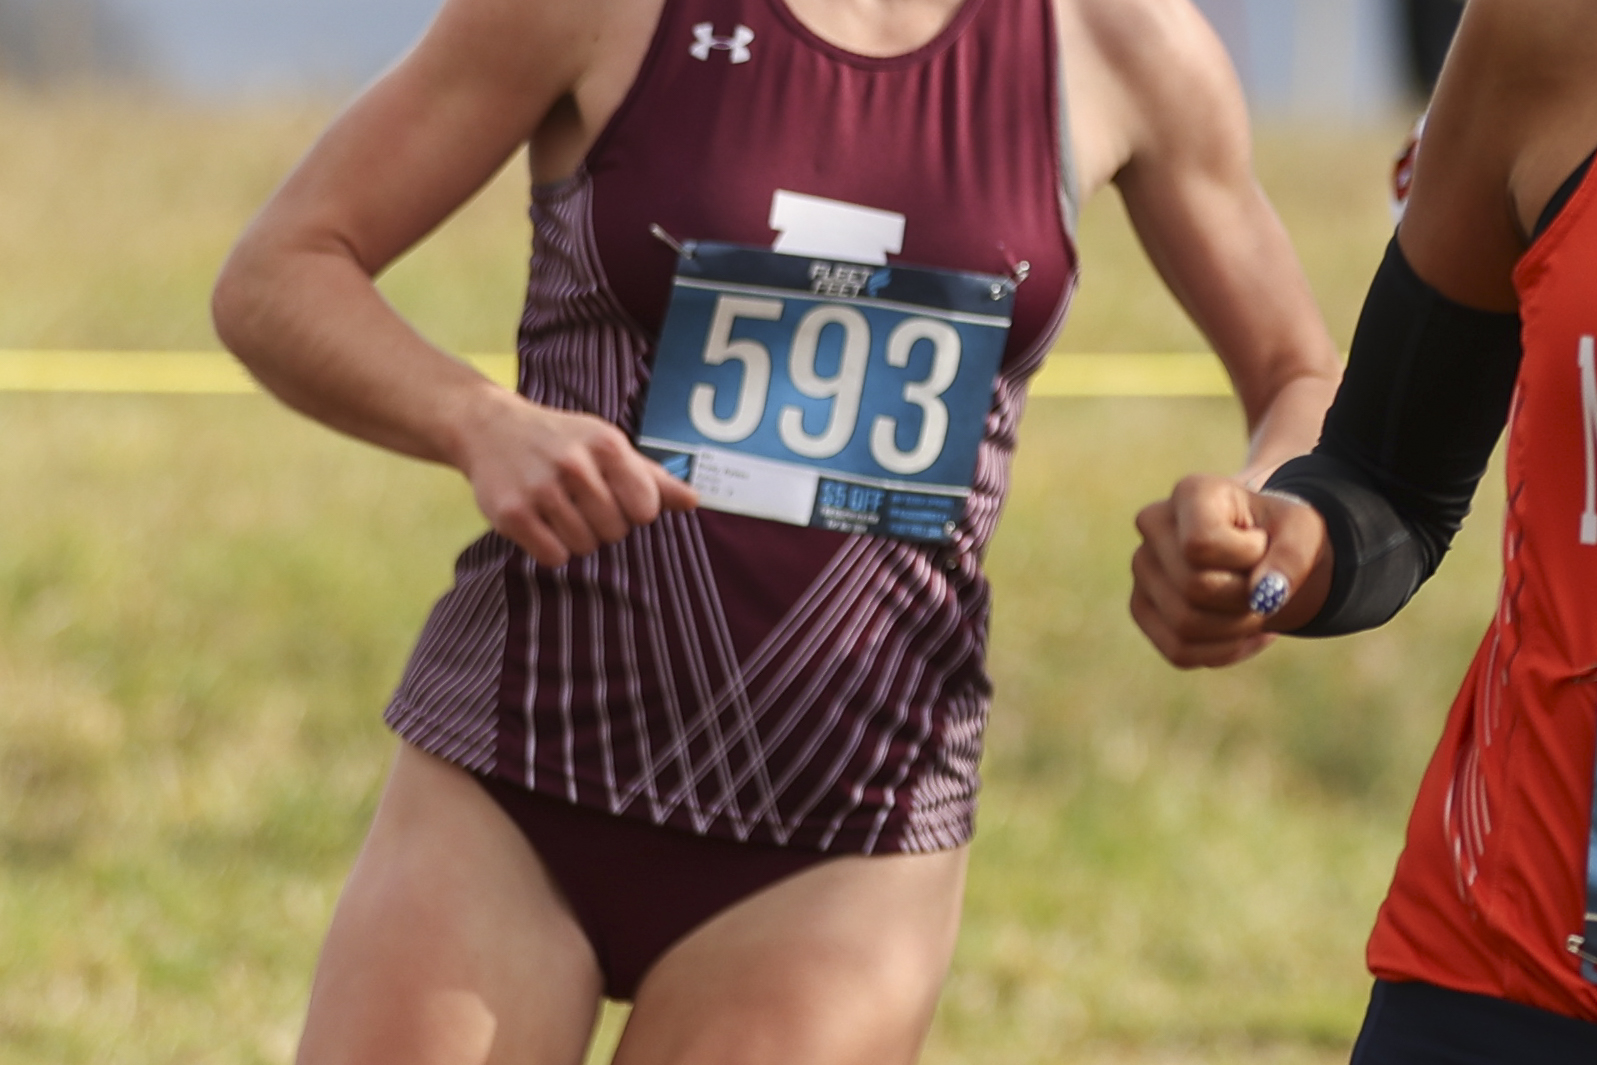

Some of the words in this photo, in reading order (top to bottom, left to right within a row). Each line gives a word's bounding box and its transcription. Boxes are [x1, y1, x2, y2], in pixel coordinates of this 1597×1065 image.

[808, 261, 873, 286] FLEET
[812, 279, 863, 299] FEET
[688, 294, 963, 476] 593
[819, 480, 848, 509] $5
[849, 485, 887, 513] OFF
